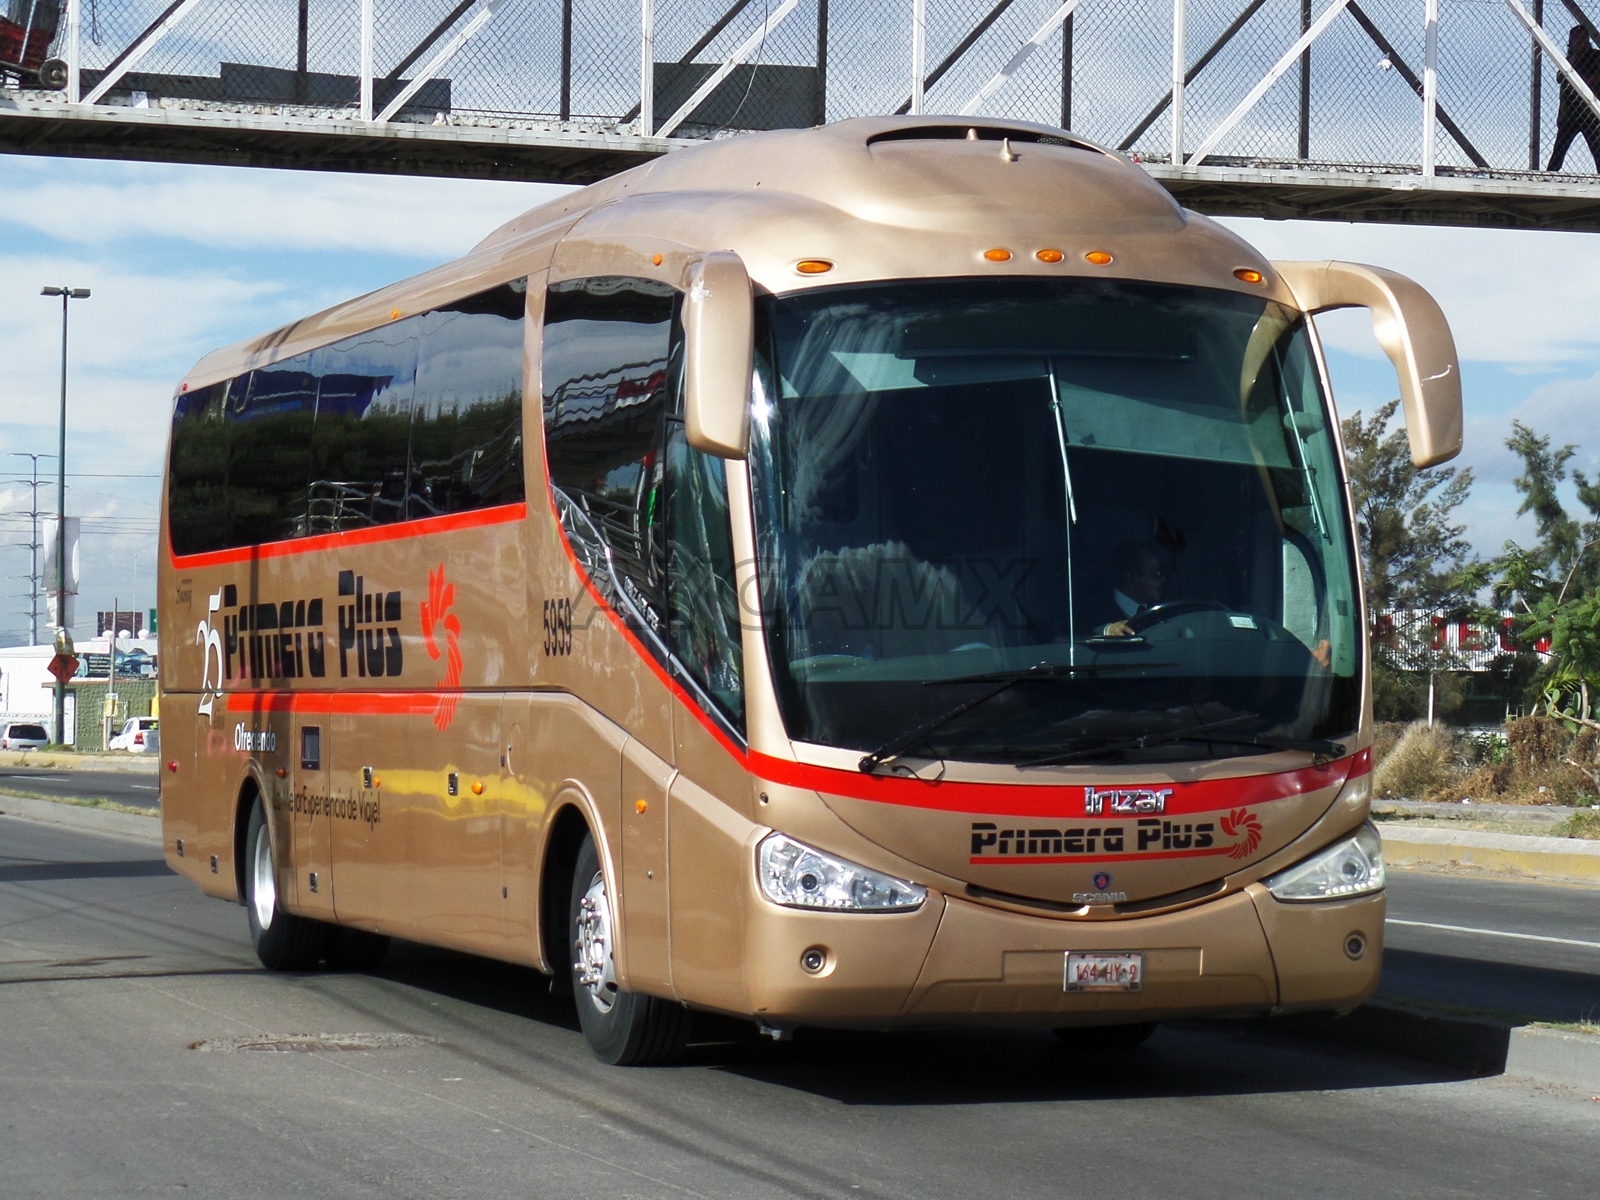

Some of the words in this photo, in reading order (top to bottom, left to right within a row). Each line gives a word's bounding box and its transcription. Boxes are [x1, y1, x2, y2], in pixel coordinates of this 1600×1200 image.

[223, 583, 326, 680] Primera
[338, 569, 404, 678] Plus
[543, 597, 572, 657] 5959
[234, 721, 276, 752] Ofreciendo
[971, 822, 1124, 854] Primera
[1137, 818, 1214, 851] Plus
[1072, 891, 1128, 903] SCANIA
